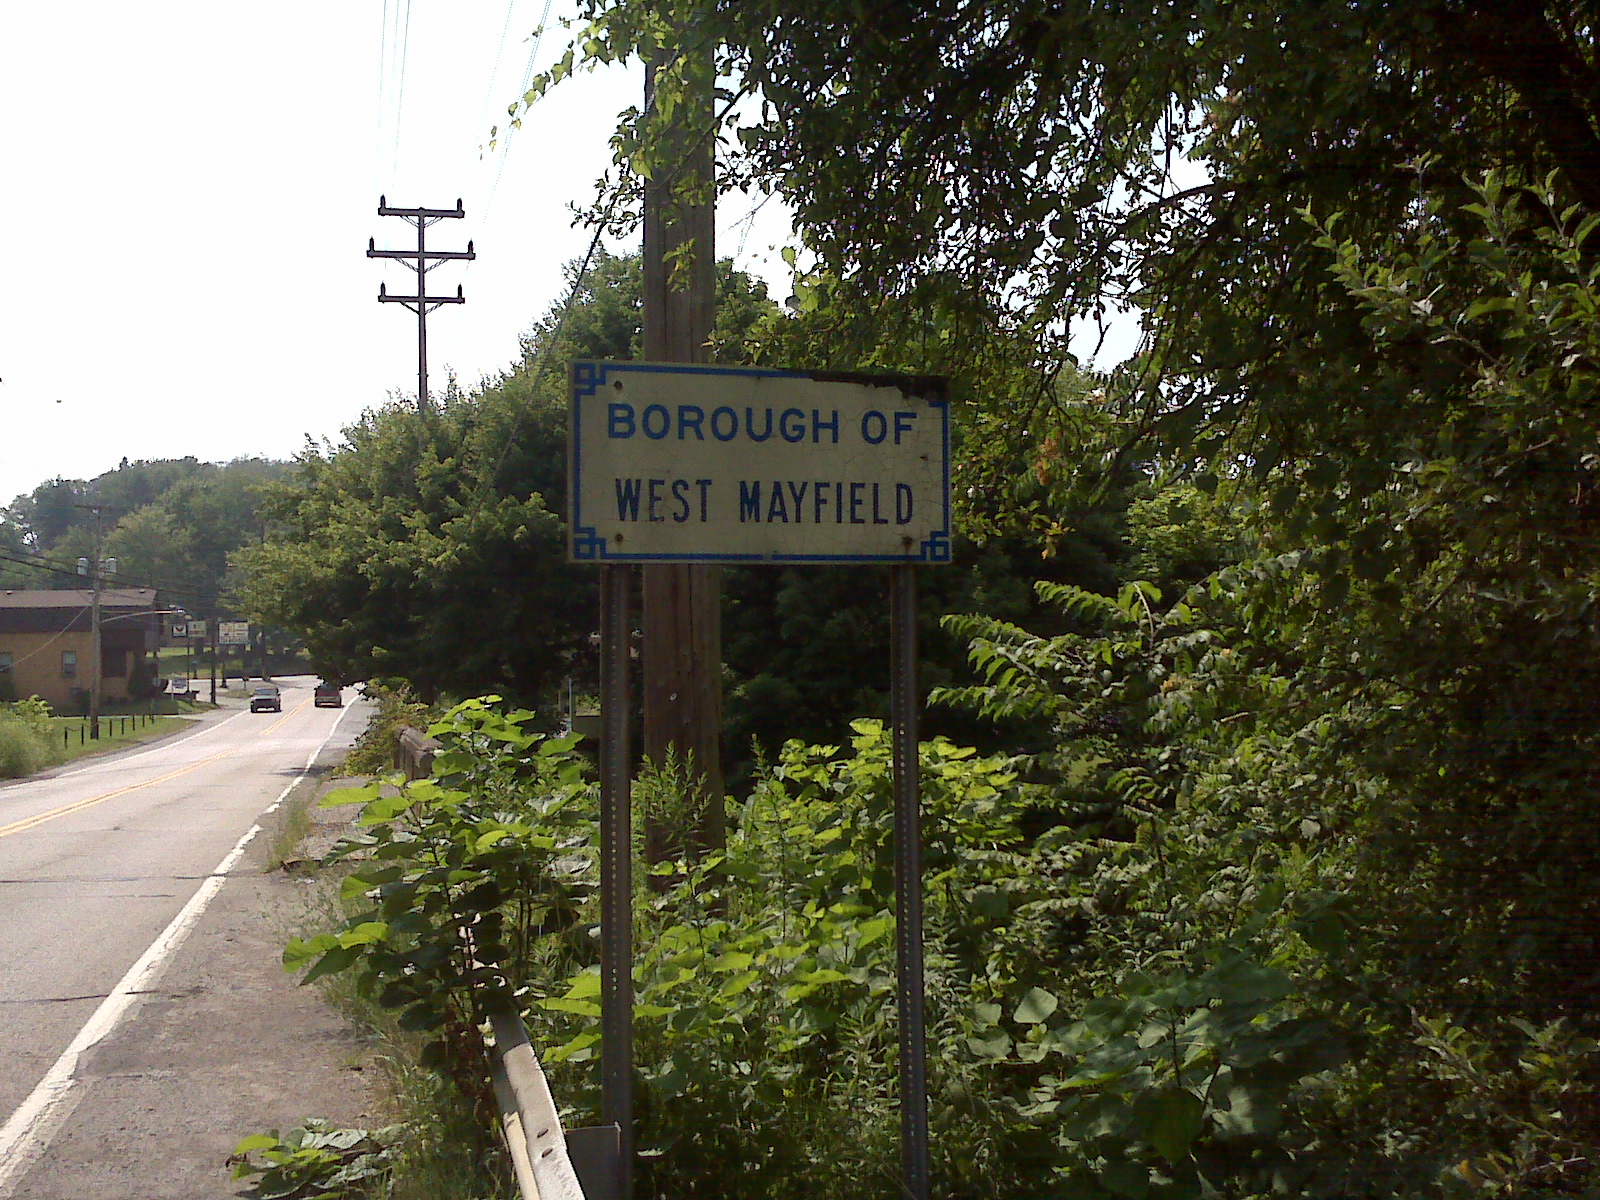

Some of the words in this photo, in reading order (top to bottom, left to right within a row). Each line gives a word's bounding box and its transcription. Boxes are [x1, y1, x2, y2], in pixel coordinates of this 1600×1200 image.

[608, 403, 839, 443] BOROUGH
[861, 410, 917, 445] OF
[615, 478, 712, 523] WEST
[739, 480, 914, 525] MAYFIELD
